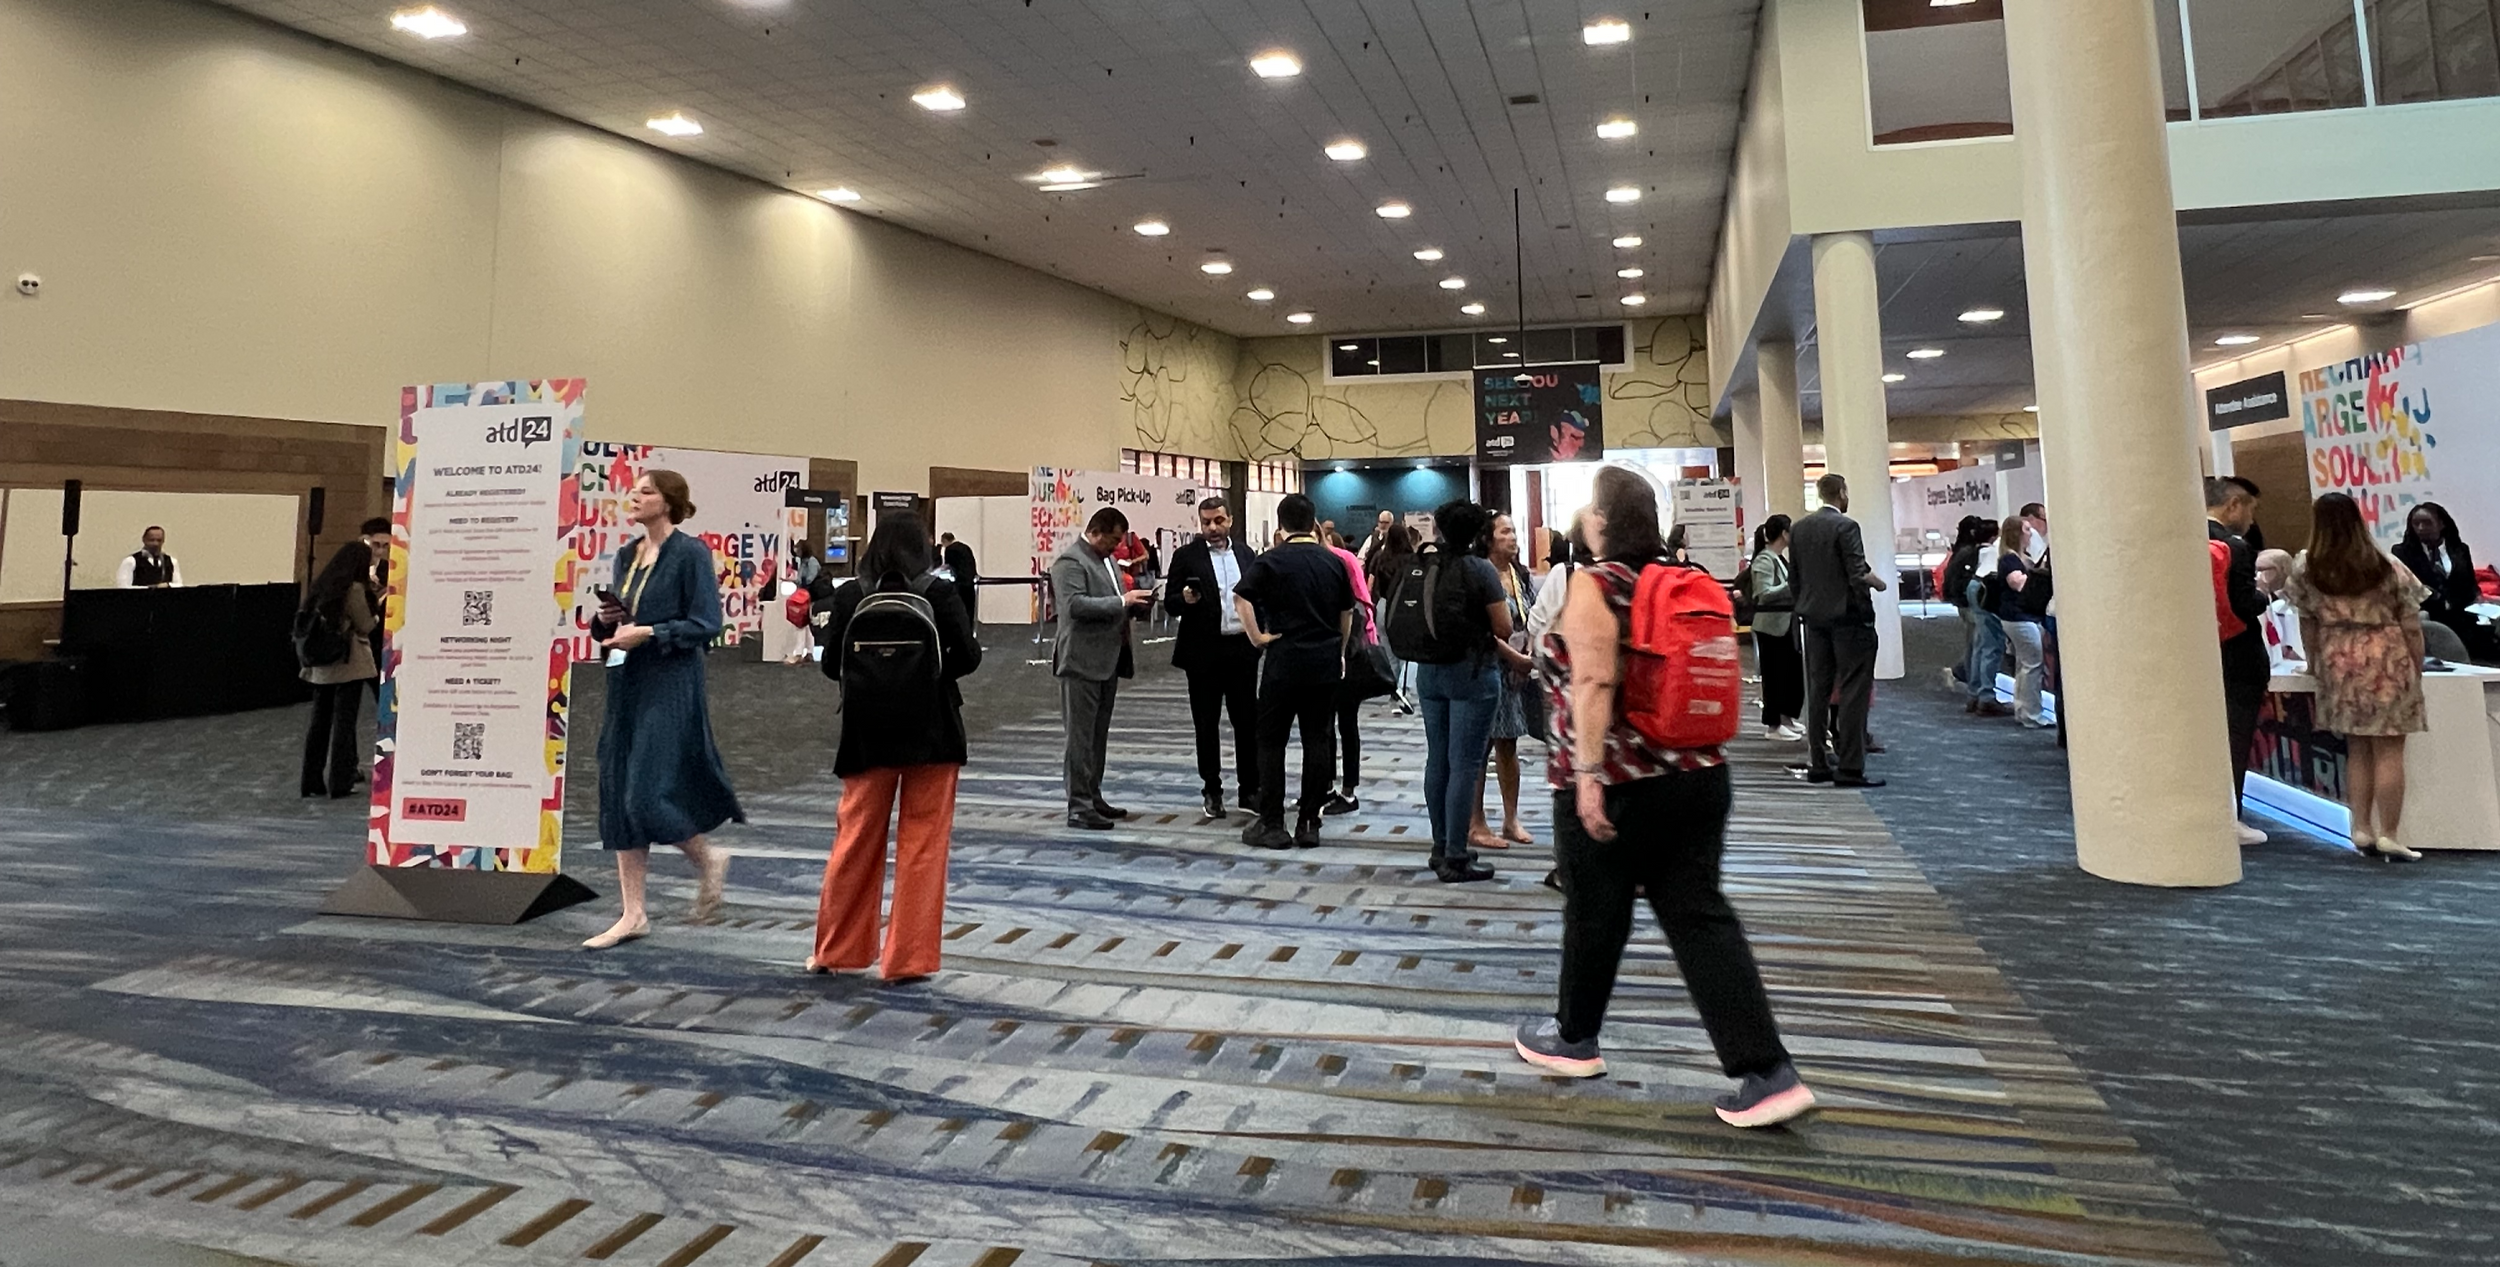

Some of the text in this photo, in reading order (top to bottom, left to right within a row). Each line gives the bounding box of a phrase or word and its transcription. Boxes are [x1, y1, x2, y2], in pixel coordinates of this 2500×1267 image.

[1484, 377, 1514, 390] SEE
[1484, 392, 1531, 407] NEXT
[433, 464, 542, 477] WELCOME TO ATD24!
[1096, 486, 1115, 504] Bag
[1117, 487, 1151, 506] Pick-Up
[1966, 479, 1991, 504] Pick-Up
[444, 769, 473, 777] FORGET
[408, 803, 460, 817] #ATD24
